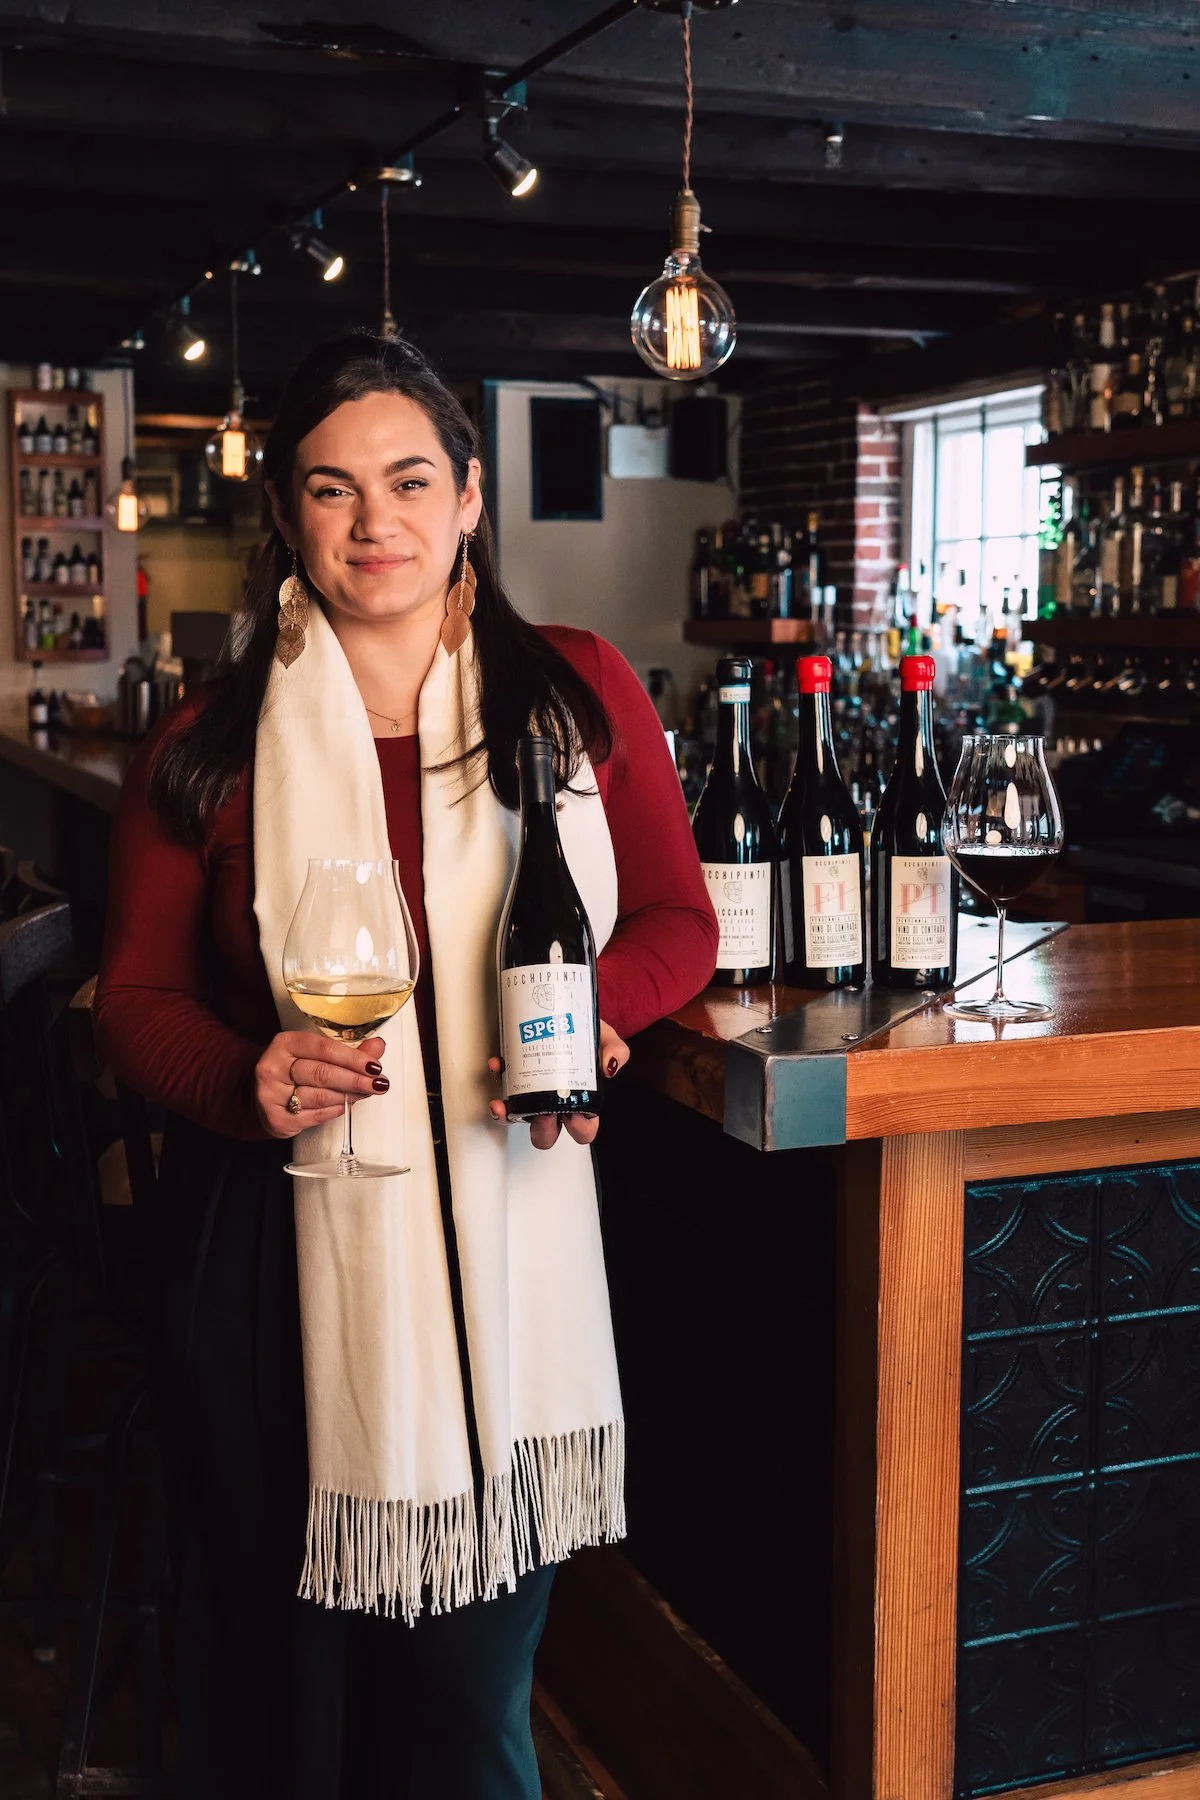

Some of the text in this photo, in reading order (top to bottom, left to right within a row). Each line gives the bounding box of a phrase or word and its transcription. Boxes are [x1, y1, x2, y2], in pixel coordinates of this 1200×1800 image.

[900, 883, 945, 915] PT
[717, 908, 754, 916] ICCAGNO
[811, 922, 857, 934] VINO DI CONTRADA
[897, 924, 945, 934] VINO DI CONTRADA
[506, 971, 584, 988] OCCHIPINTI
[522, 1017, 570, 1039] SP68
